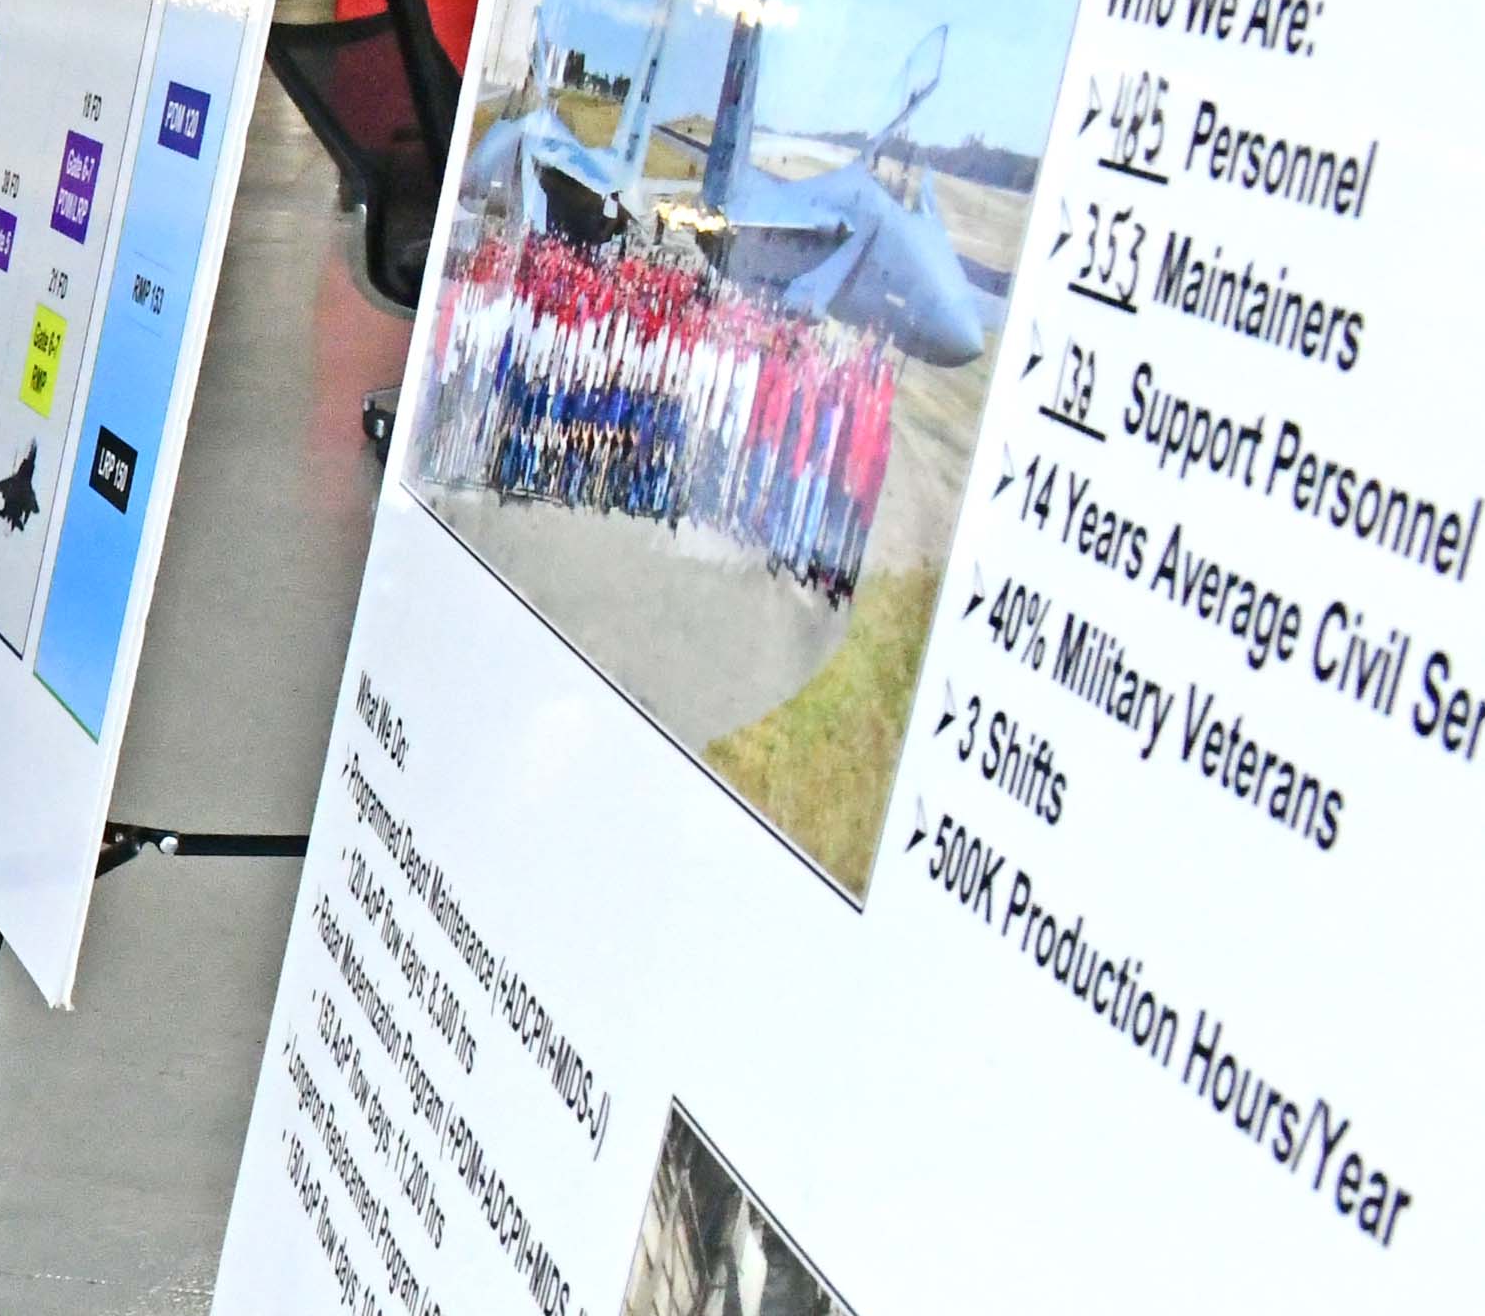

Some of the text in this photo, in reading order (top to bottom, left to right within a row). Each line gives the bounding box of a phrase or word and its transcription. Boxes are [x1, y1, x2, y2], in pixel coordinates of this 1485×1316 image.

[66, 148, 83, 180] Gate
[165, 99, 200, 139] PDM 120
[1108, 69, 1379, 219] 485 Personnel
[131, 273, 165, 316] RMP 153
[1078, 200, 1366, 373] 353 Maintainers
[97, 447, 115, 482] LRP
[1123, 362, 1265, 488] Support
[1265, 419, 1485, 583] Personnel
[1020, 453, 1058, 531] 14
[1063, 470, 1147, 580] Years
[1150, 523, 1302, 671] Average
[1313, 600, 1412, 717] Civil
[355, 669, 410, 773] What We Do:
[959, 695, 1070, 827] 3 Shifts
[987, 576, 1345, 852] 40% Military Veterans
[347, 751, 406, 860] Programmed
[399, 826, 433, 902] Depot
[427, 865, 496, 993] Maintenance
[347, 846, 367, 901] 120
[361, 871, 385, 927] AoP
[381, 898, 405, 961] flow
[427, 970, 460, 1045] 8,300
[455, 1009, 478, 1075] hrs
[318, 892, 345, 963] Radar
[340, 932, 402, 1065] Modernization
[399, 1030, 445, 1136] Program
[929, 813, 1412, 1249] 500K Production Hours/Year
[286, 1131, 305, 1189] 150
[298, 1162, 322, 1219] AoP
[316, 1194, 339, 1262] flow
[288, 1032, 326, 1135] Longeron
[321, 1101, 381, 1241] Replacement
[317, 990, 336, 1046] 153
[330, 1017, 353, 1074] AoP
[348, 1047, 371, 1113] flow
[394, 1129, 430, 1216] 11,200
[423, 1182, 446, 1250] hrs
